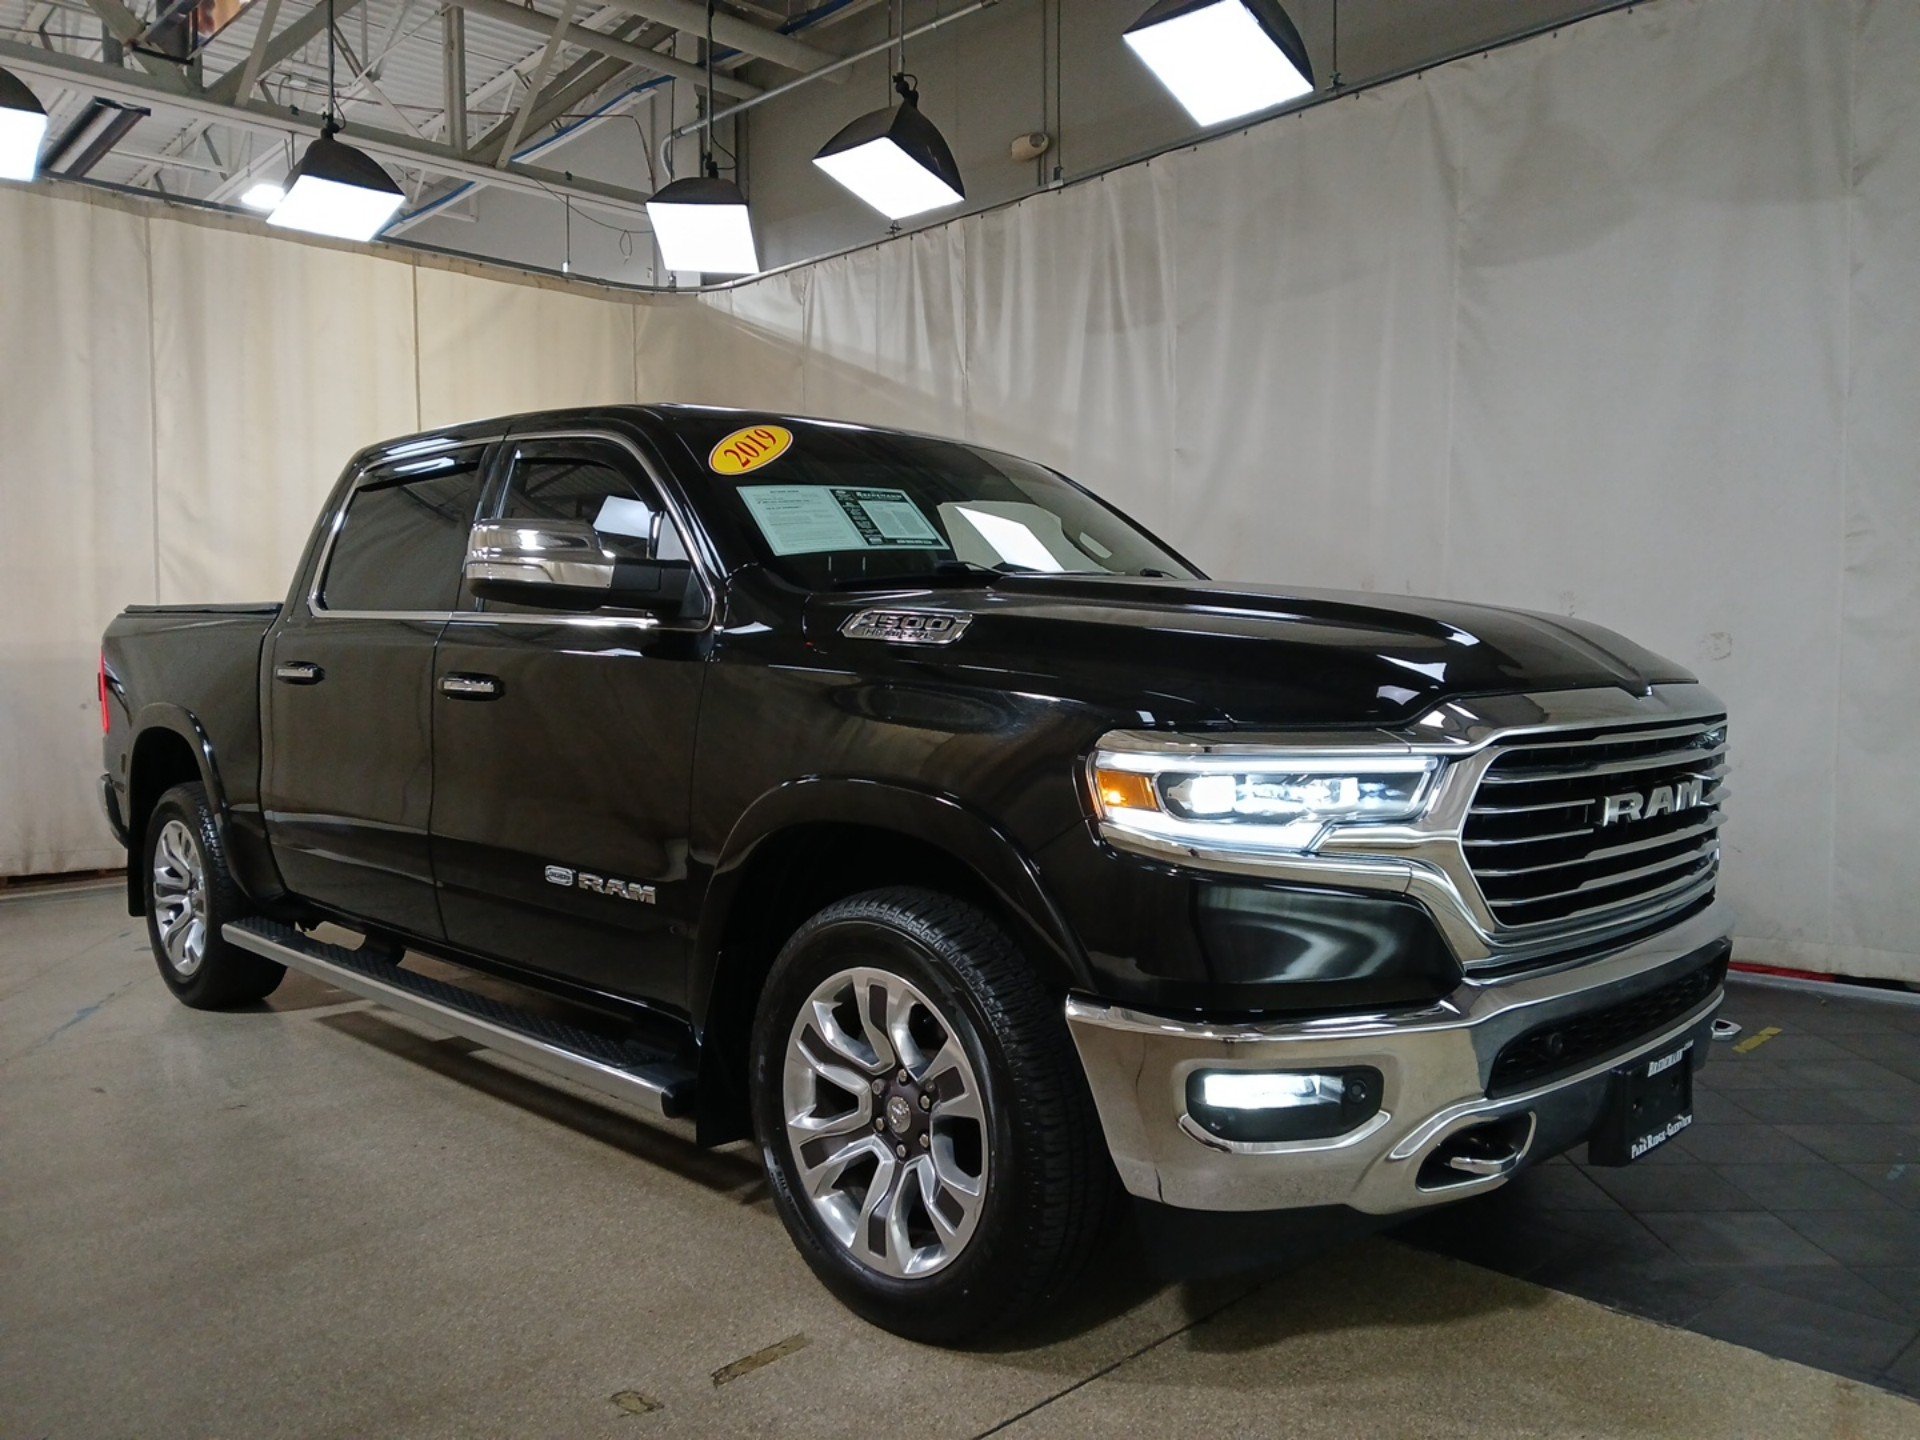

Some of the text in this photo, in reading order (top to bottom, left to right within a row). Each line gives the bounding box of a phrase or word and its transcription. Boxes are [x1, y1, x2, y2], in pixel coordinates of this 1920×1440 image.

[724, 428, 777, 468] 2019
[860, 613, 952, 631] 1500
[1603, 779, 1703, 828] RAM
[578, 872, 656, 905] RAM
